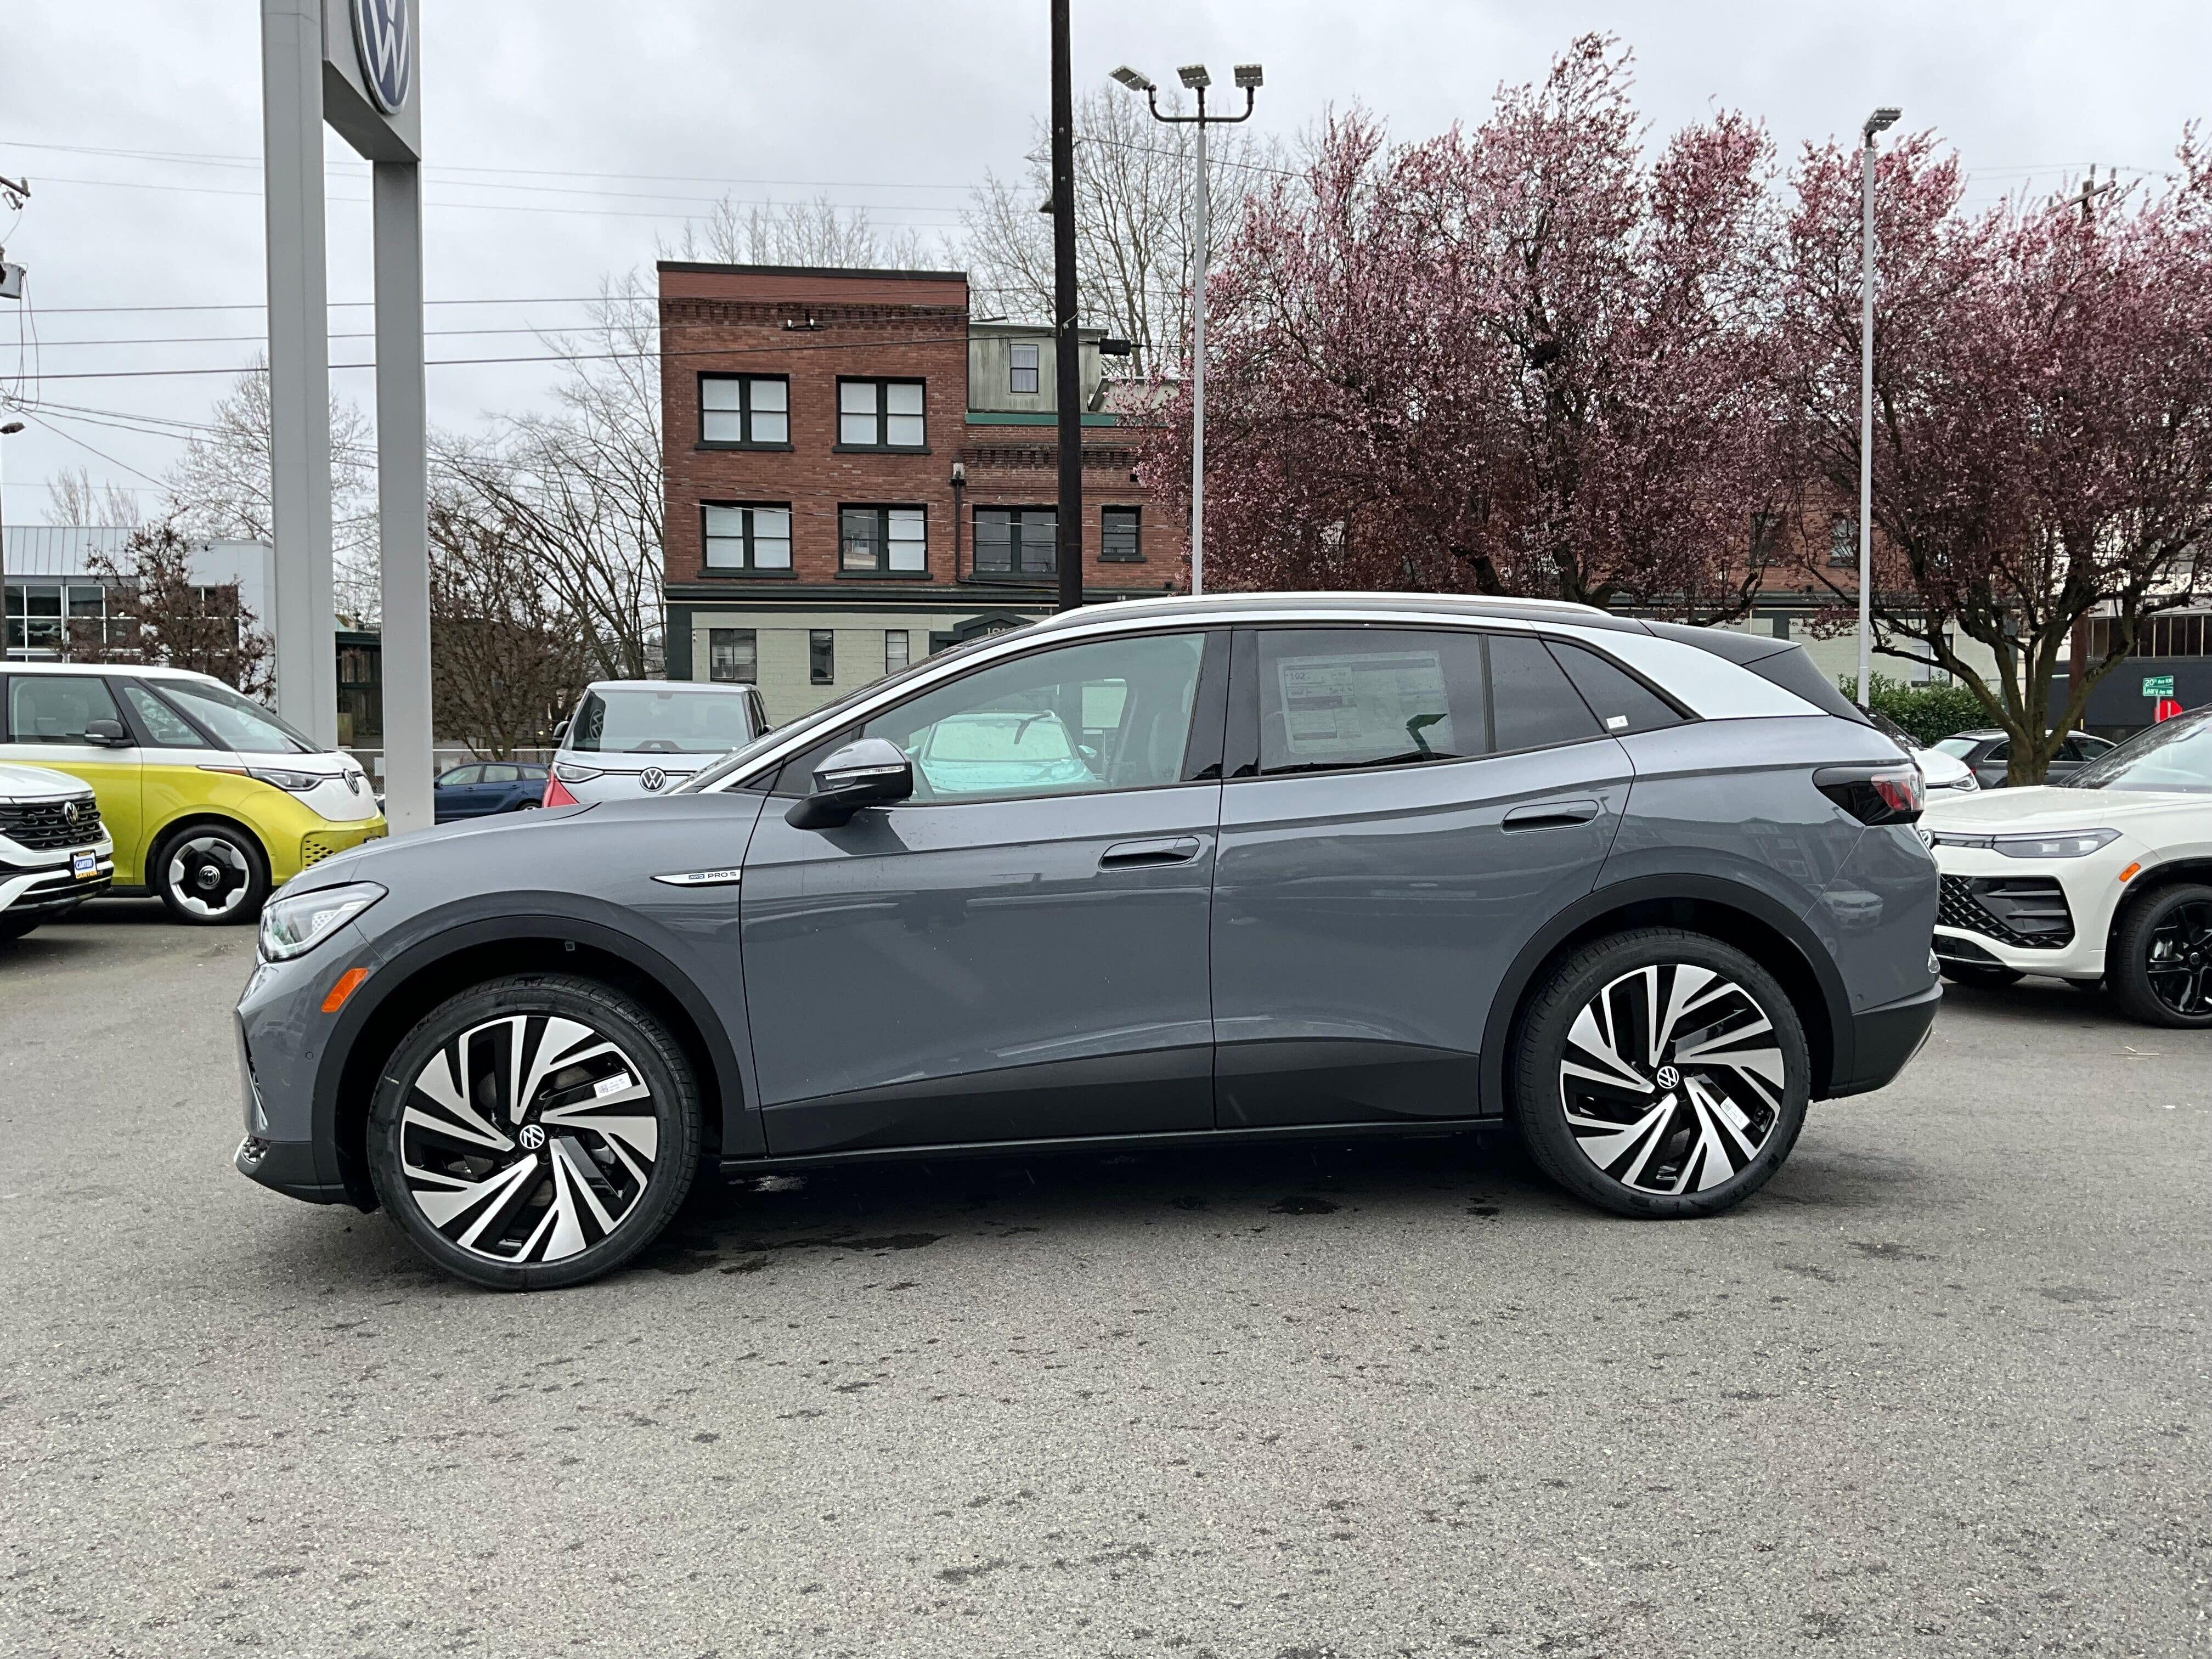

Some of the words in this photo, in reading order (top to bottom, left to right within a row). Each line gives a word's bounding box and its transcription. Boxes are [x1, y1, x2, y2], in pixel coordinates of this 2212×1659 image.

[640, 768, 665, 790] VW
[76, 859, 93, 869] CARTER
[1657, 1066, 1679, 1088] VW
[520, 1125, 544, 1149] VW
